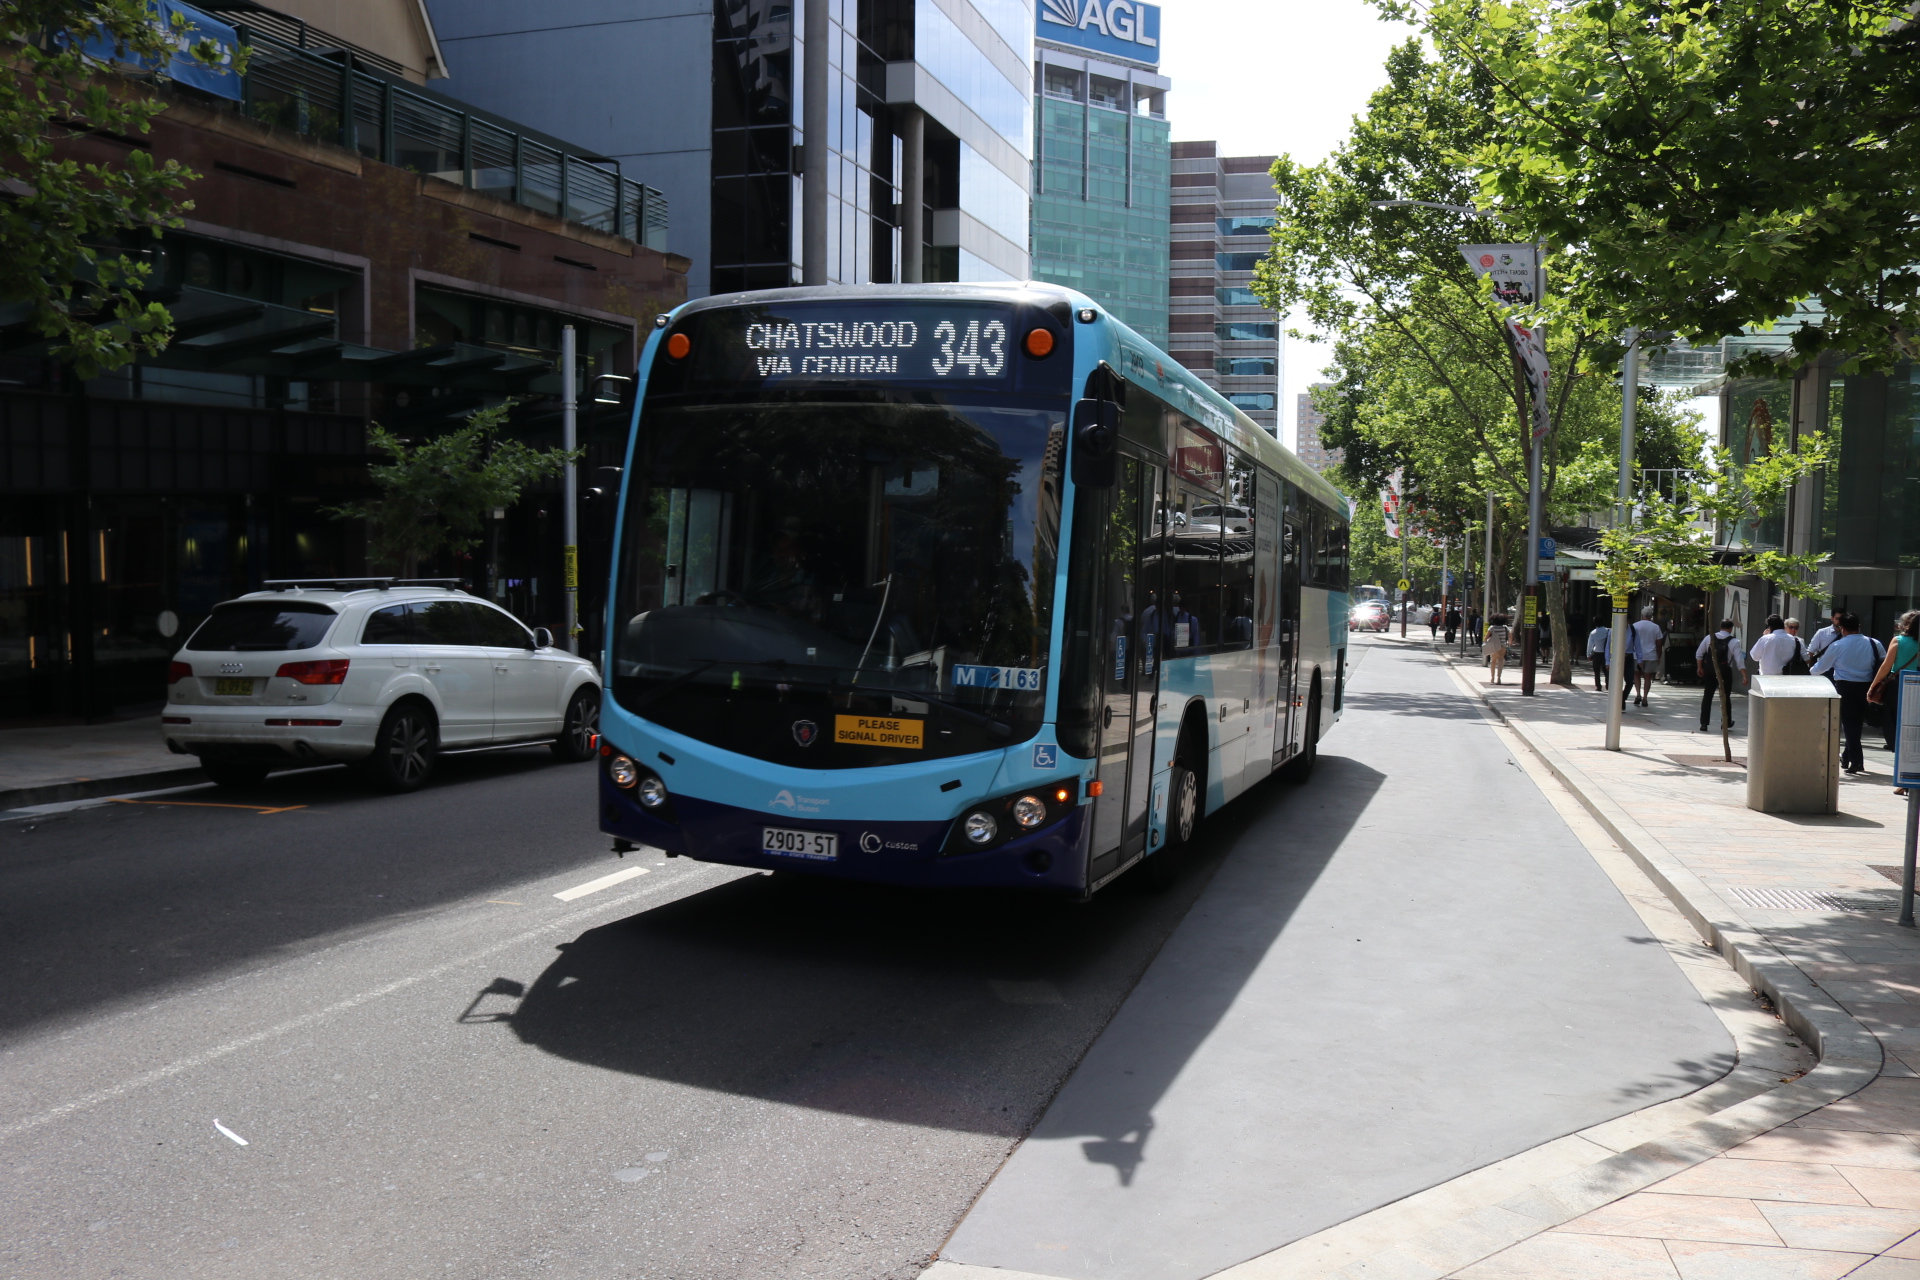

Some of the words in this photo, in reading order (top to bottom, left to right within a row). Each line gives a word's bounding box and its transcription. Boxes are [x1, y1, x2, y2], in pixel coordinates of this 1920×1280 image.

[1078, 0, 1157, 47] AGL
[745, 321, 918, 349] CHATSWOOD
[931, 320, 1006, 376] 343
[756, 355, 792, 376] VIA
[956, 667, 976, 685] M
[858, 719, 900, 731] PLEASE
[838, 730, 878, 742] SIGNAL
[880, 733, 919, 745] DRIVER
[796, 795, 830, 805] Transport
[797, 804, 820, 813] Buses
[885, 840, 919, 851] custom
